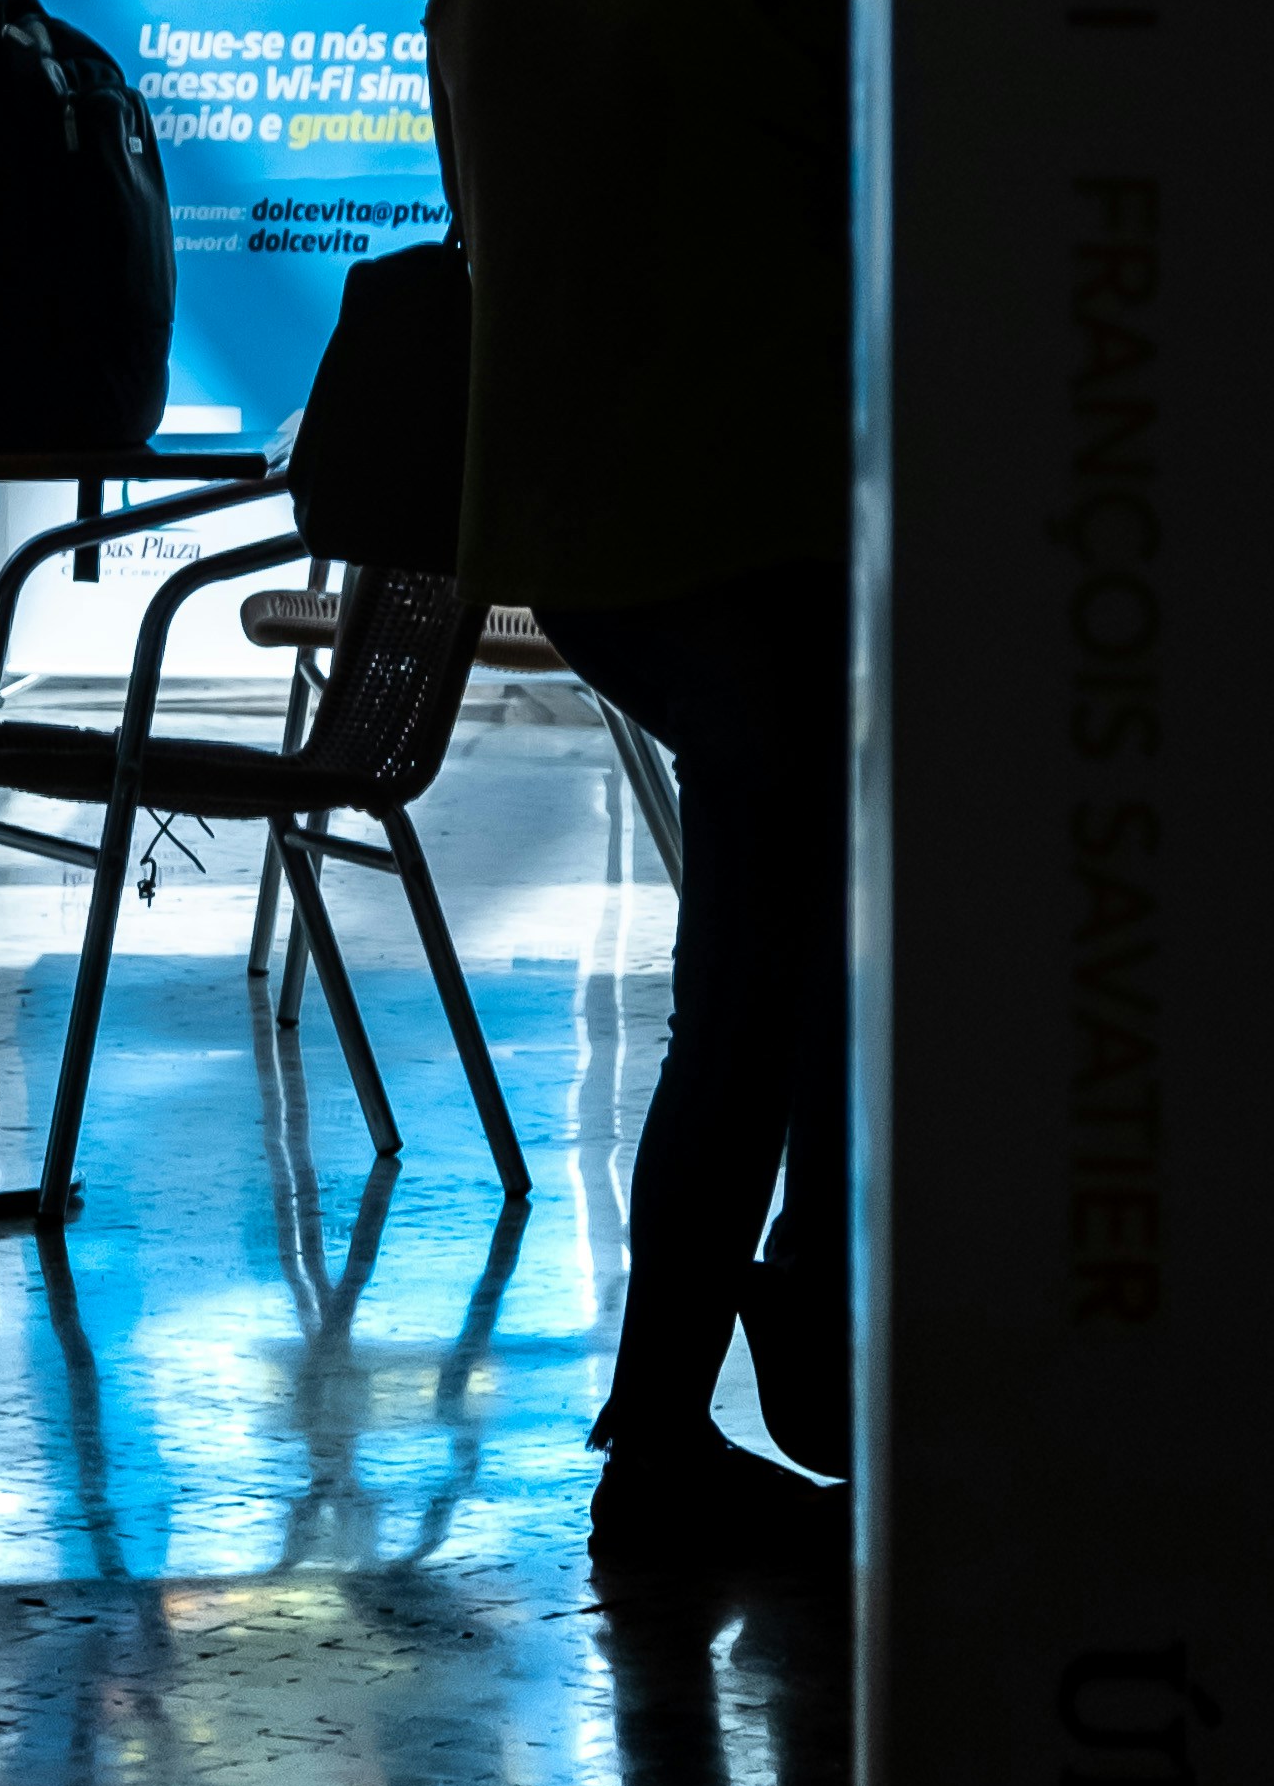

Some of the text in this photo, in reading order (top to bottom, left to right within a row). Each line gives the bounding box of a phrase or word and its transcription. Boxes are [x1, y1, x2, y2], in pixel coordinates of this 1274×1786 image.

[138, 22, 286, 67] Ligue-se
[290, 30, 317, 61] a
[319, 22, 389, 62] nós
[139, 71, 259, 101] acesso
[266, 65, 356, 102] Wi-Fi
[151, 105, 435, 151] ápido e gratuito
[170, 204, 247, 222] rname:
[248, 228, 370, 254] dolcevita
[140, 536, 202, 560] Plaza
[1047, 177, 1166, 1328] FRANÇOIS SAVATIER
